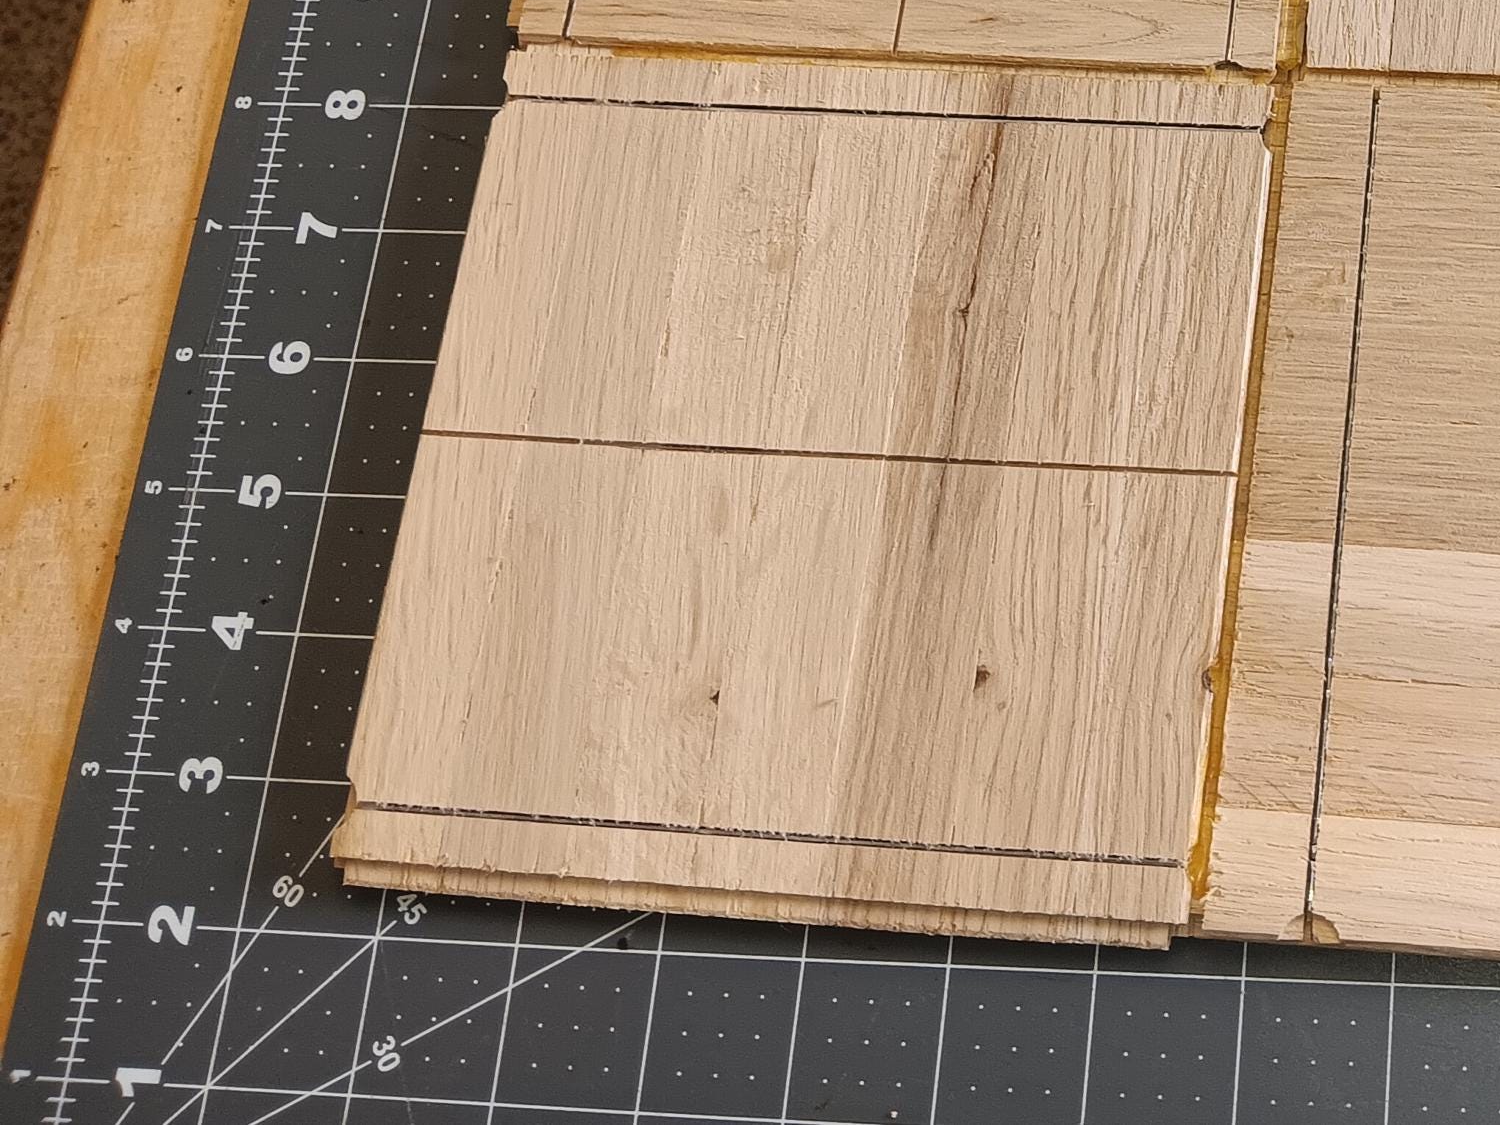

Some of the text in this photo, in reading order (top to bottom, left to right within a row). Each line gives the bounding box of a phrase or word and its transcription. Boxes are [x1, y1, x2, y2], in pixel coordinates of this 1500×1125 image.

[234, 95, 253, 110] 8
[324, 89, 366, 121] 8
[204, 218, 223, 234] 7
[295, 211, 338, 245] 7
[175, 347, 194, 362] 6
[268, 340, 311, 375] 6
[144, 480, 163, 495] 5
[237, 473, 282, 510] 5
[114, 617, 133, 634] 4
[211, 611, 255, 651] 4
[80, 761, 100, 777] 3
[178, 756, 224, 794] 3
[272, 875, 305, 908] 60
[46, 910, 67, 928] 2
[147, 904, 196, 946] 2
[396, 893, 428, 925] 45
[372, 1035, 401, 1072] 30
[9, 1069, 31, 1083] 1
[114, 1066, 163, 1098] 1
